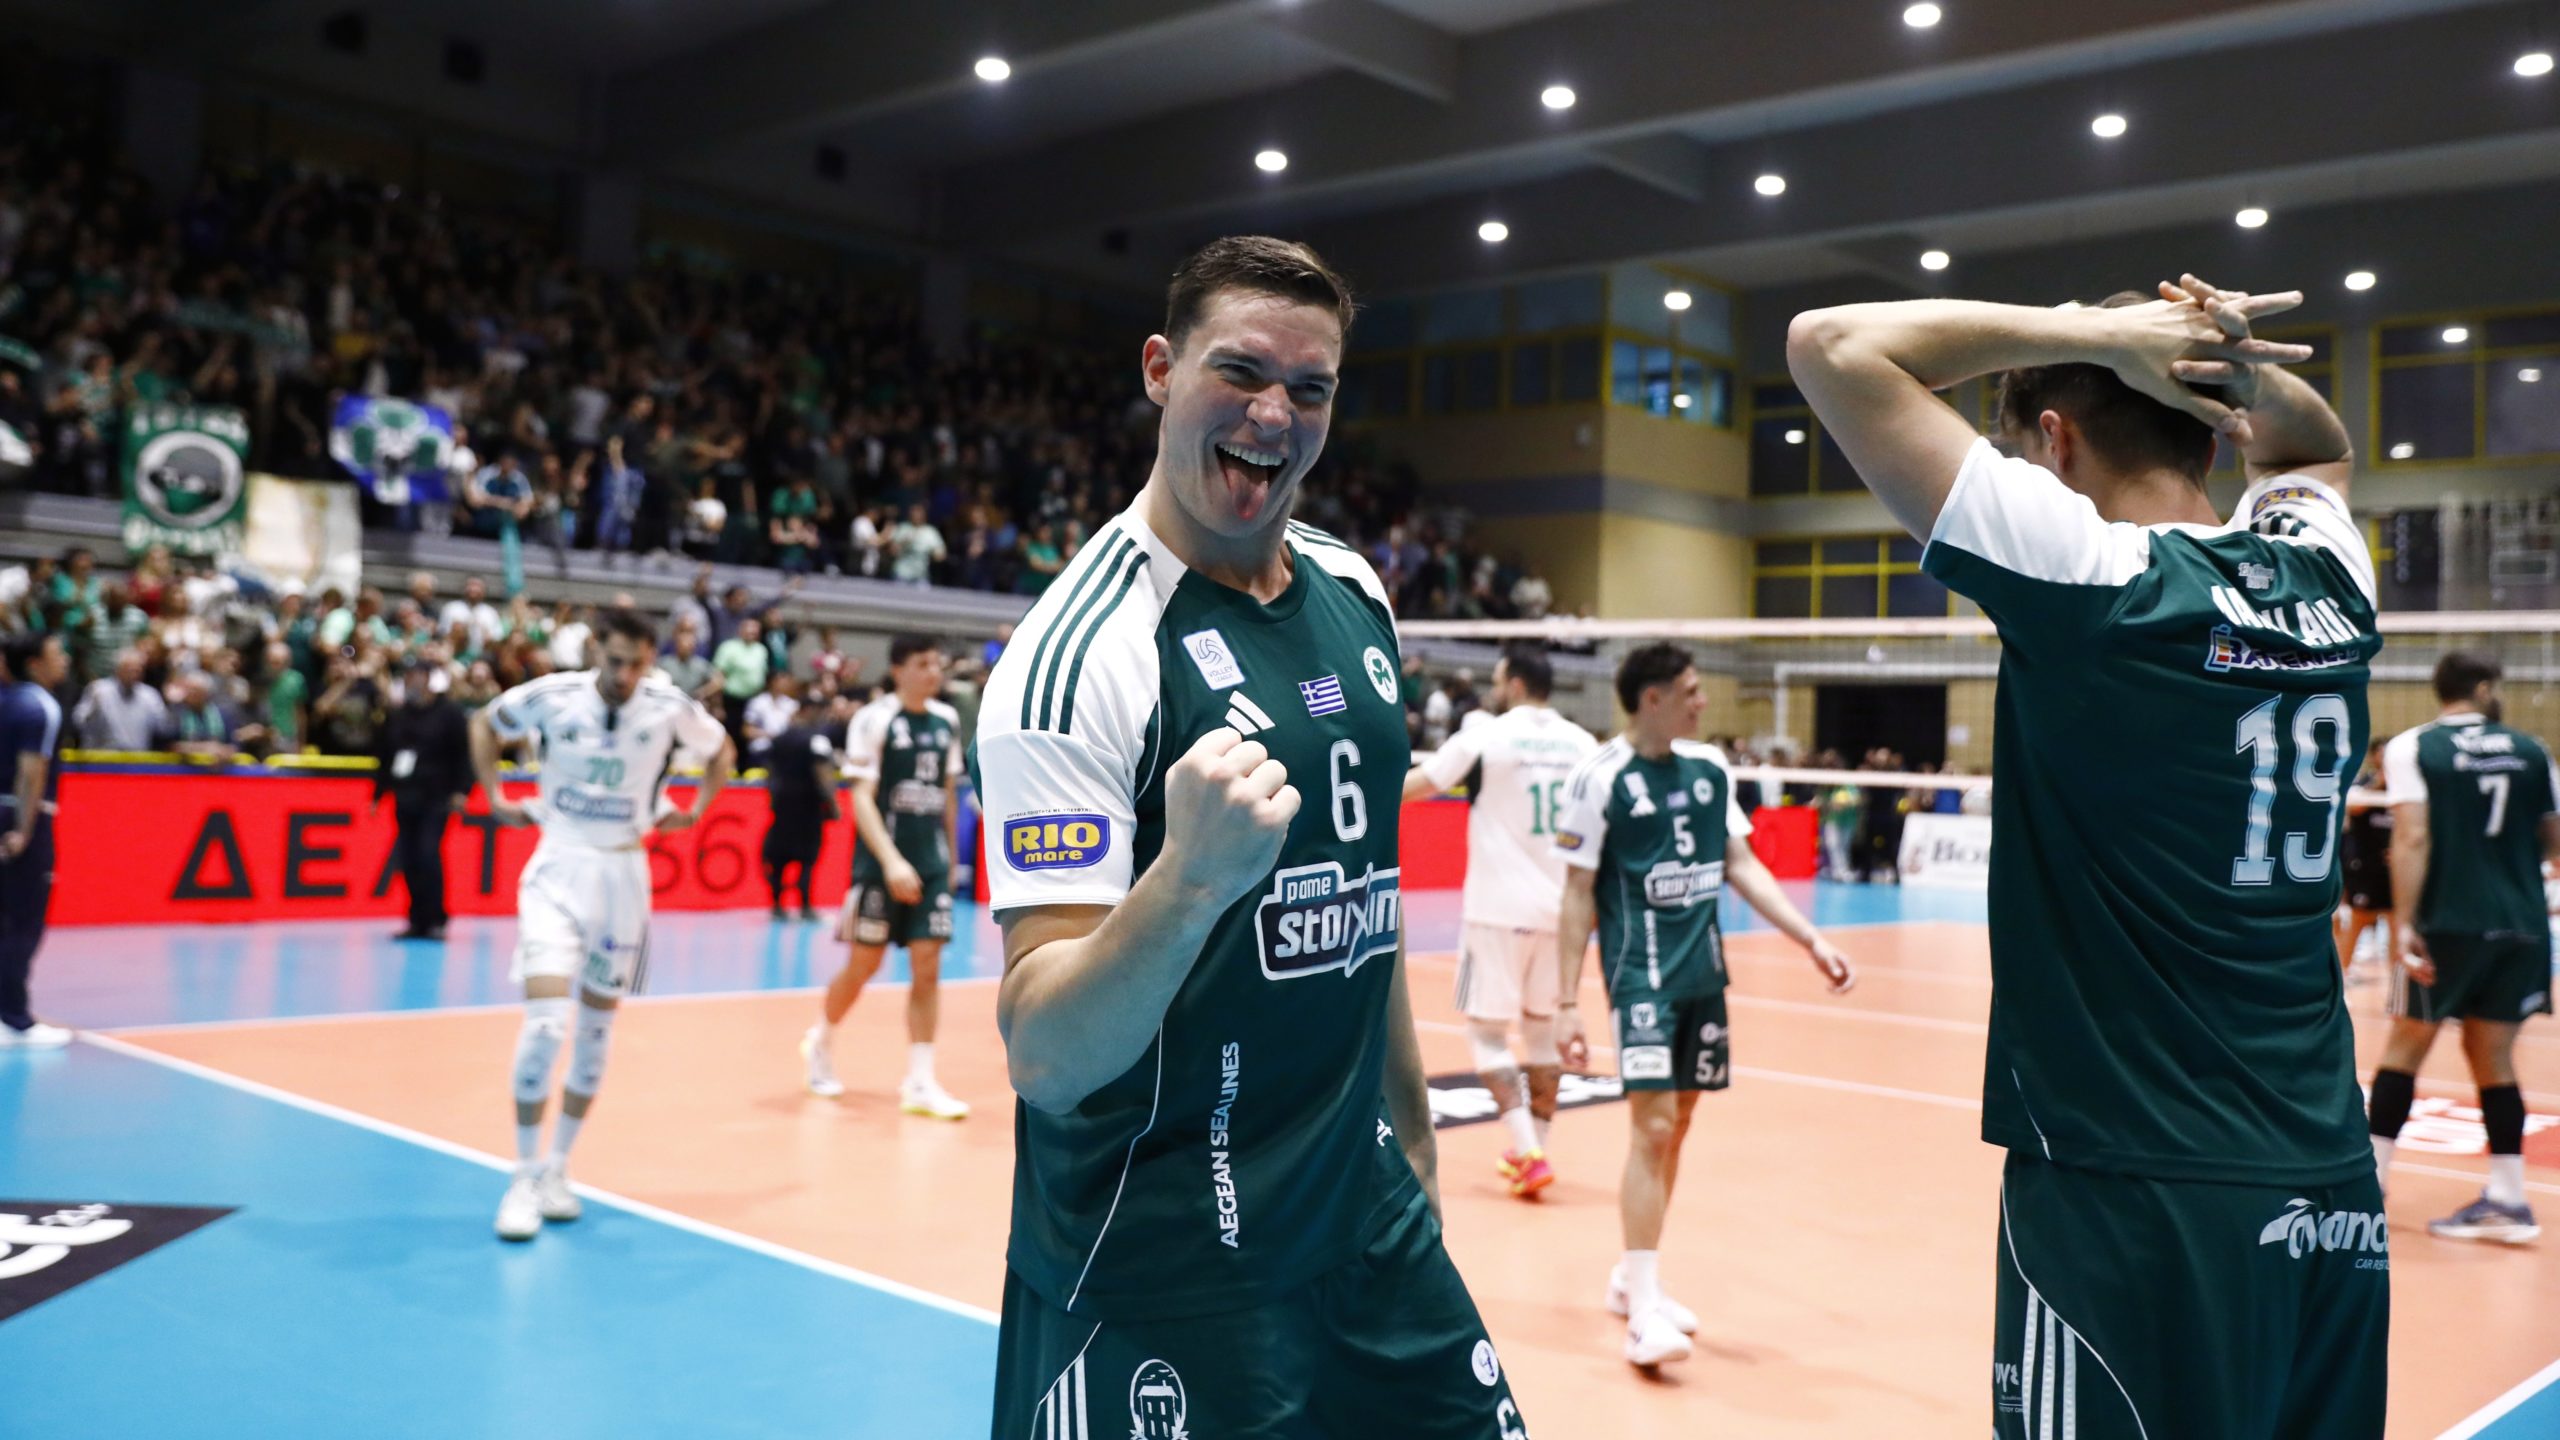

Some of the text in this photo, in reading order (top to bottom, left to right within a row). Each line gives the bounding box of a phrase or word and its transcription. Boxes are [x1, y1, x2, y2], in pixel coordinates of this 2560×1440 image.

[1208, 665, 1233, 678] VOLLEY
[1330, 739, 1368, 843] 6
[2231, 692, 2351, 886] 19
[2478, 774, 2510, 837] 7
[1012, 822, 1100, 854] RIO
[1673, 815, 1696, 857] 5
[1024, 850, 1083, 864] mare
[1286, 875, 1332, 905] pame
[1210, 1041, 1240, 1249] AEGEAN SEALINES
[2355, 1258, 2372, 1269] CAR
